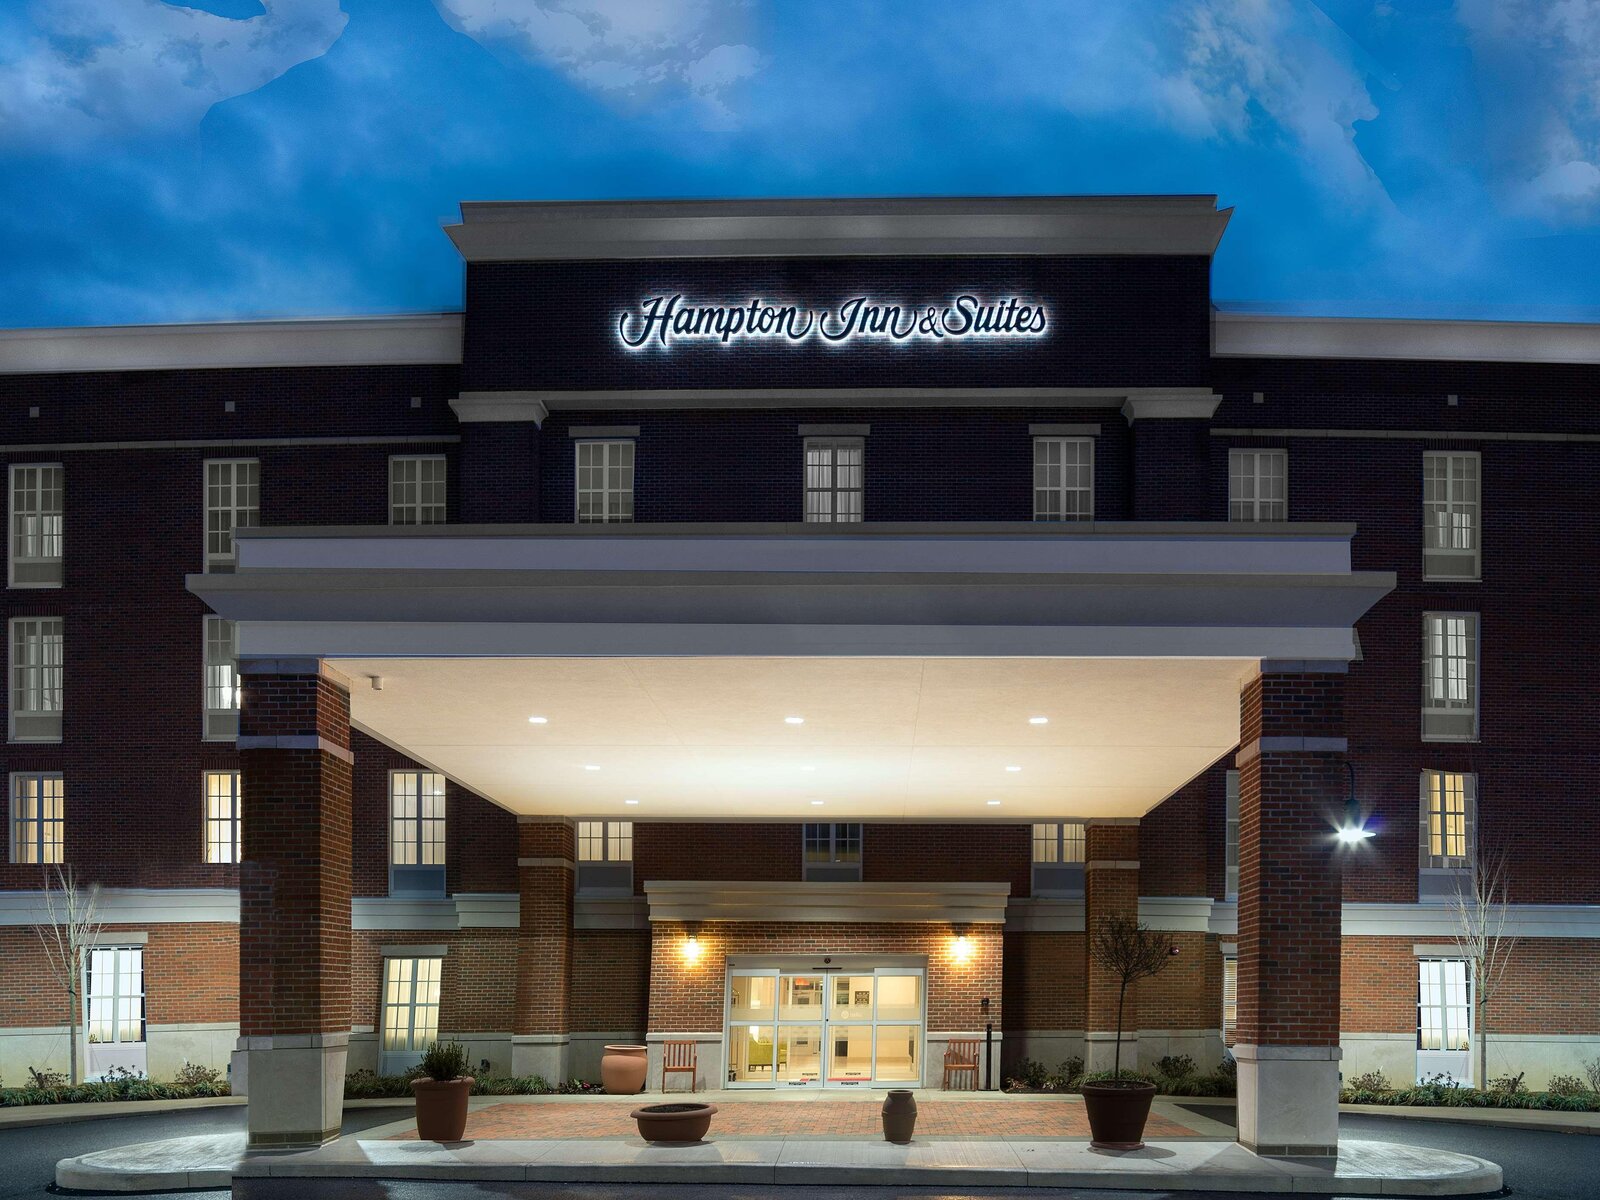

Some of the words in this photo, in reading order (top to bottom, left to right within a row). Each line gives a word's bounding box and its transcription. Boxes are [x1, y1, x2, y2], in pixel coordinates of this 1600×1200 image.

[619, 294, 813, 347] Hampton
[820, 296, 917, 340] Inn
[919, 307, 944, 338] &
[942, 295, 1047, 334] Suites
